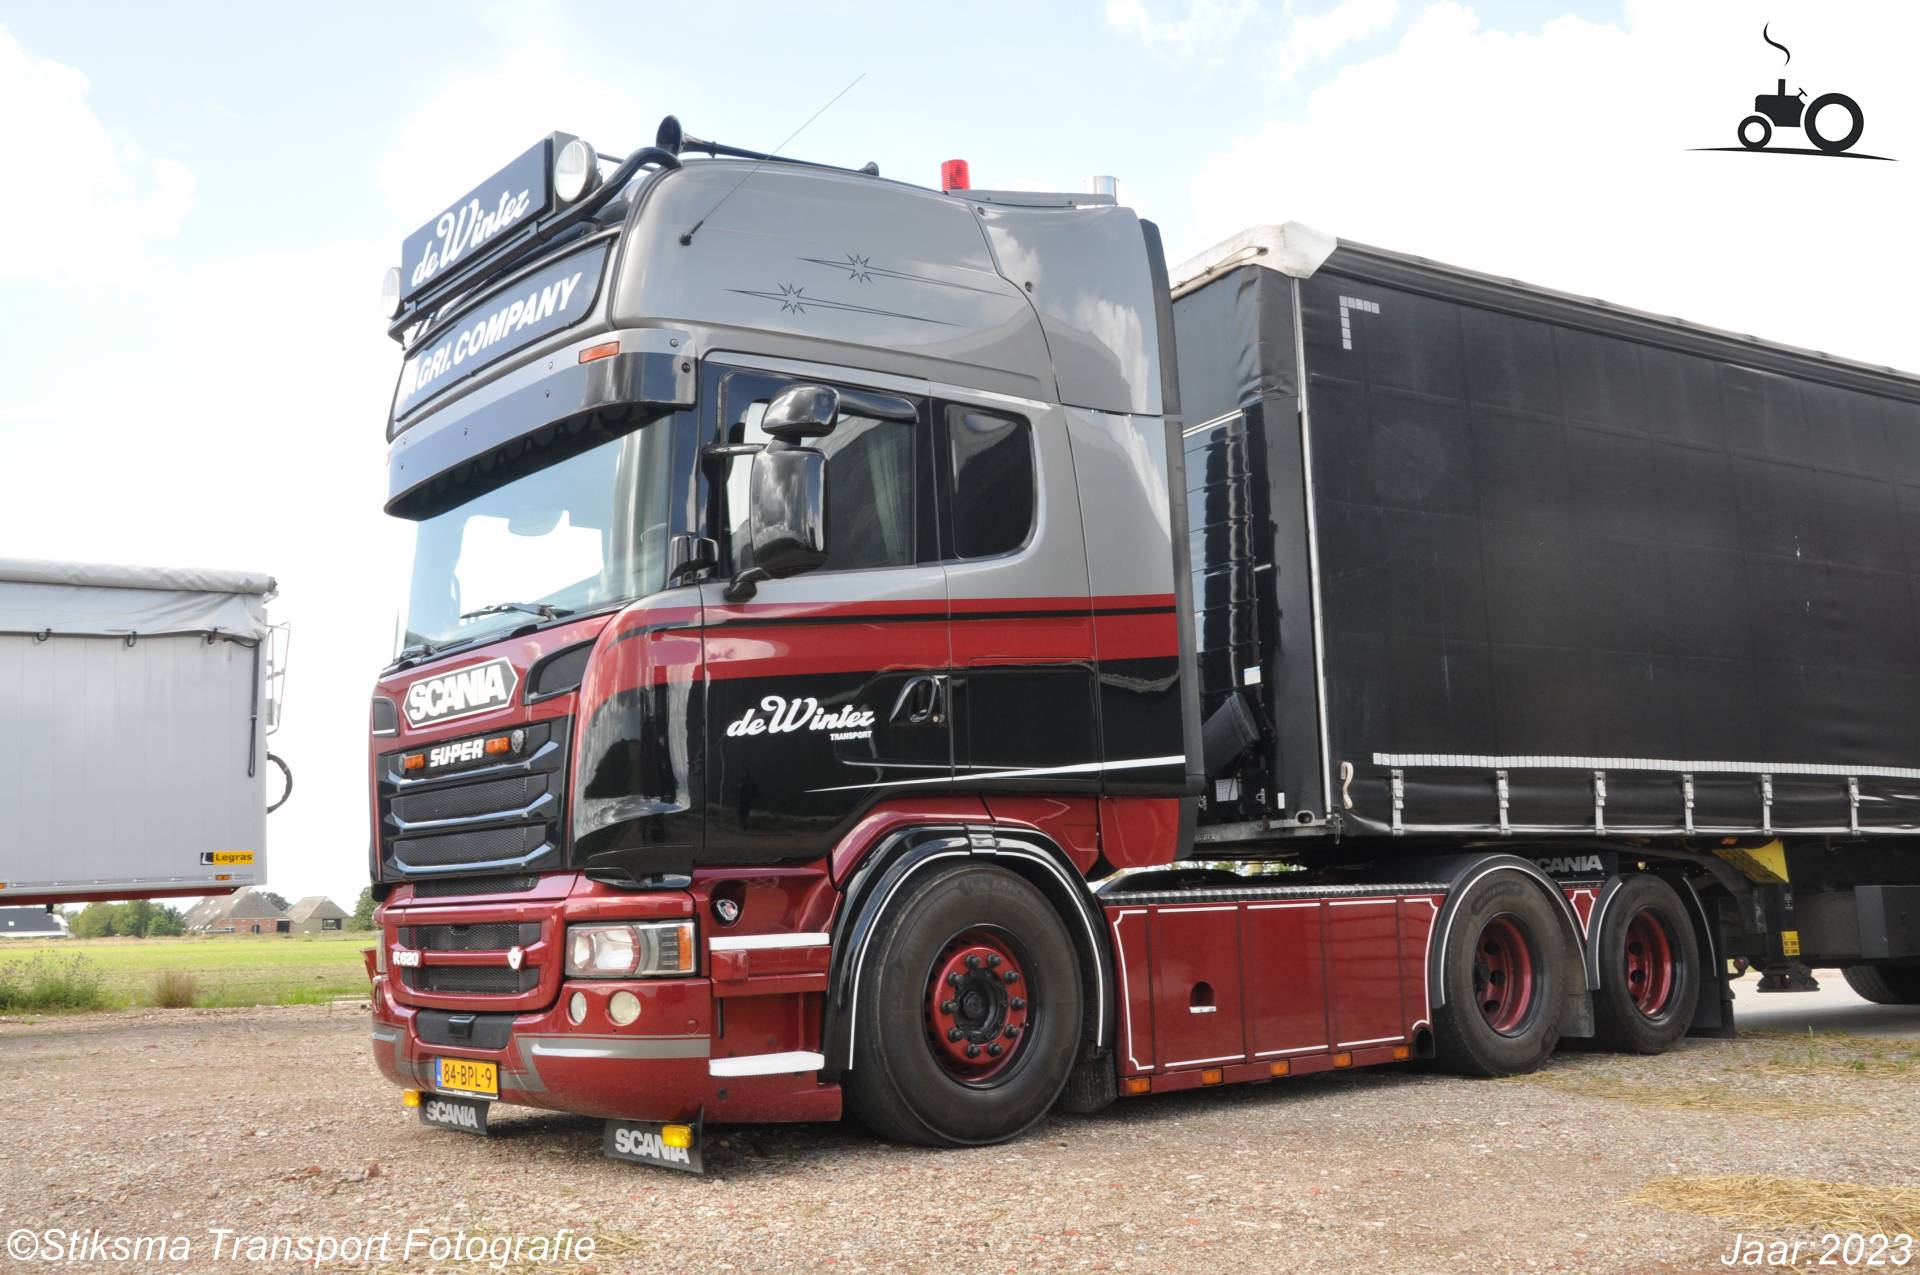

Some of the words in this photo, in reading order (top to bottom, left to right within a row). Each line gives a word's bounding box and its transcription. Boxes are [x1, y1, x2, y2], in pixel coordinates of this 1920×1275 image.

[412, 240, 439, 287] de
[453, 272, 583, 365] COMPANY
[409, 664, 507, 721] SCANIA
[727, 709, 766, 736] de
[830, 730, 872, 741] TRANSPORT
[430, 739, 484, 767] SUPER
[215, 853, 253, 863] Legras
[1533, 855, 1603, 873] CANIA
[444, 1063, 492, 1088] 84-BPL-9
[426, 1101, 478, 1128] SCANIA
